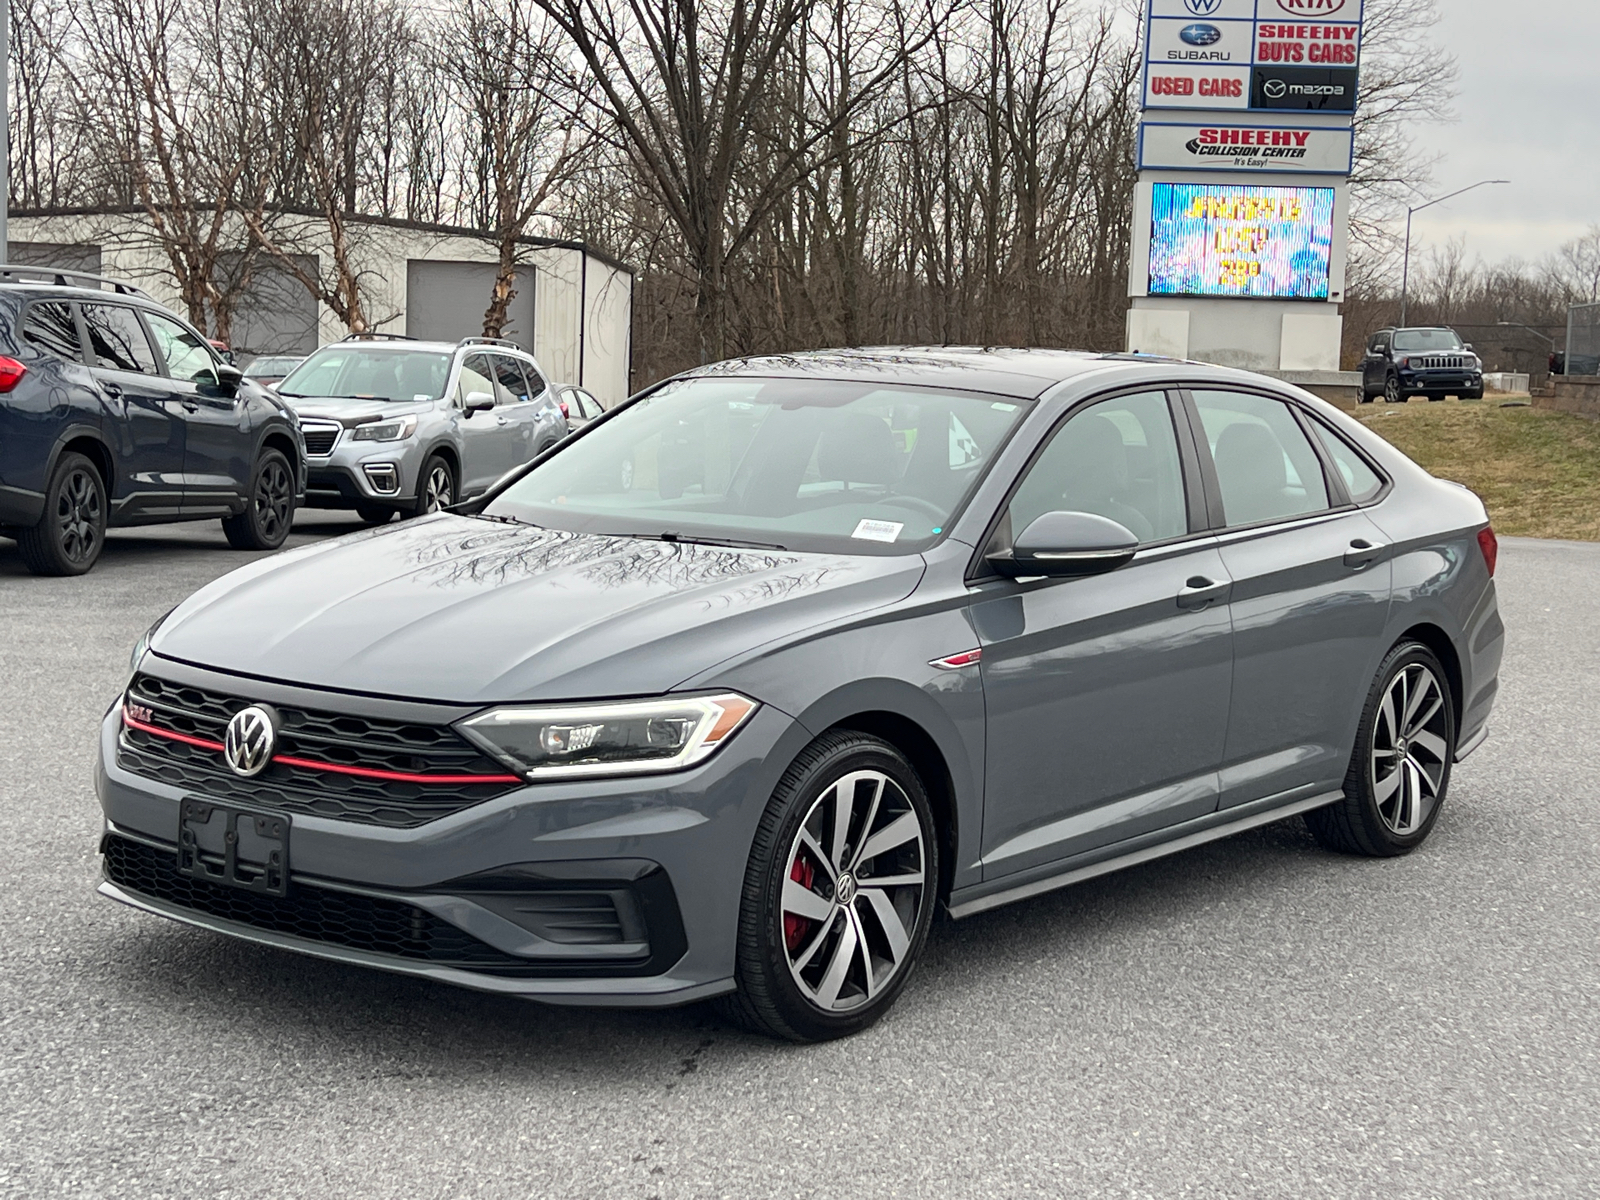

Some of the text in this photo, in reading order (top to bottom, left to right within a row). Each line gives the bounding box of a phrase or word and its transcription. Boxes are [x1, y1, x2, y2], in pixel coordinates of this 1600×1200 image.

[1258, 24, 1358, 40] SHEEHY
[1167, 50, 1231, 61] SUBARU
[1258, 42, 1356, 64] BUYS CARS
[1151, 76, 1243, 98] USED CARS
[1198, 129, 1311, 147] SHEEHY
[1198, 146, 1307, 158] COLLISION CENTER
[1234, 158, 1268, 168] It's Easy!
